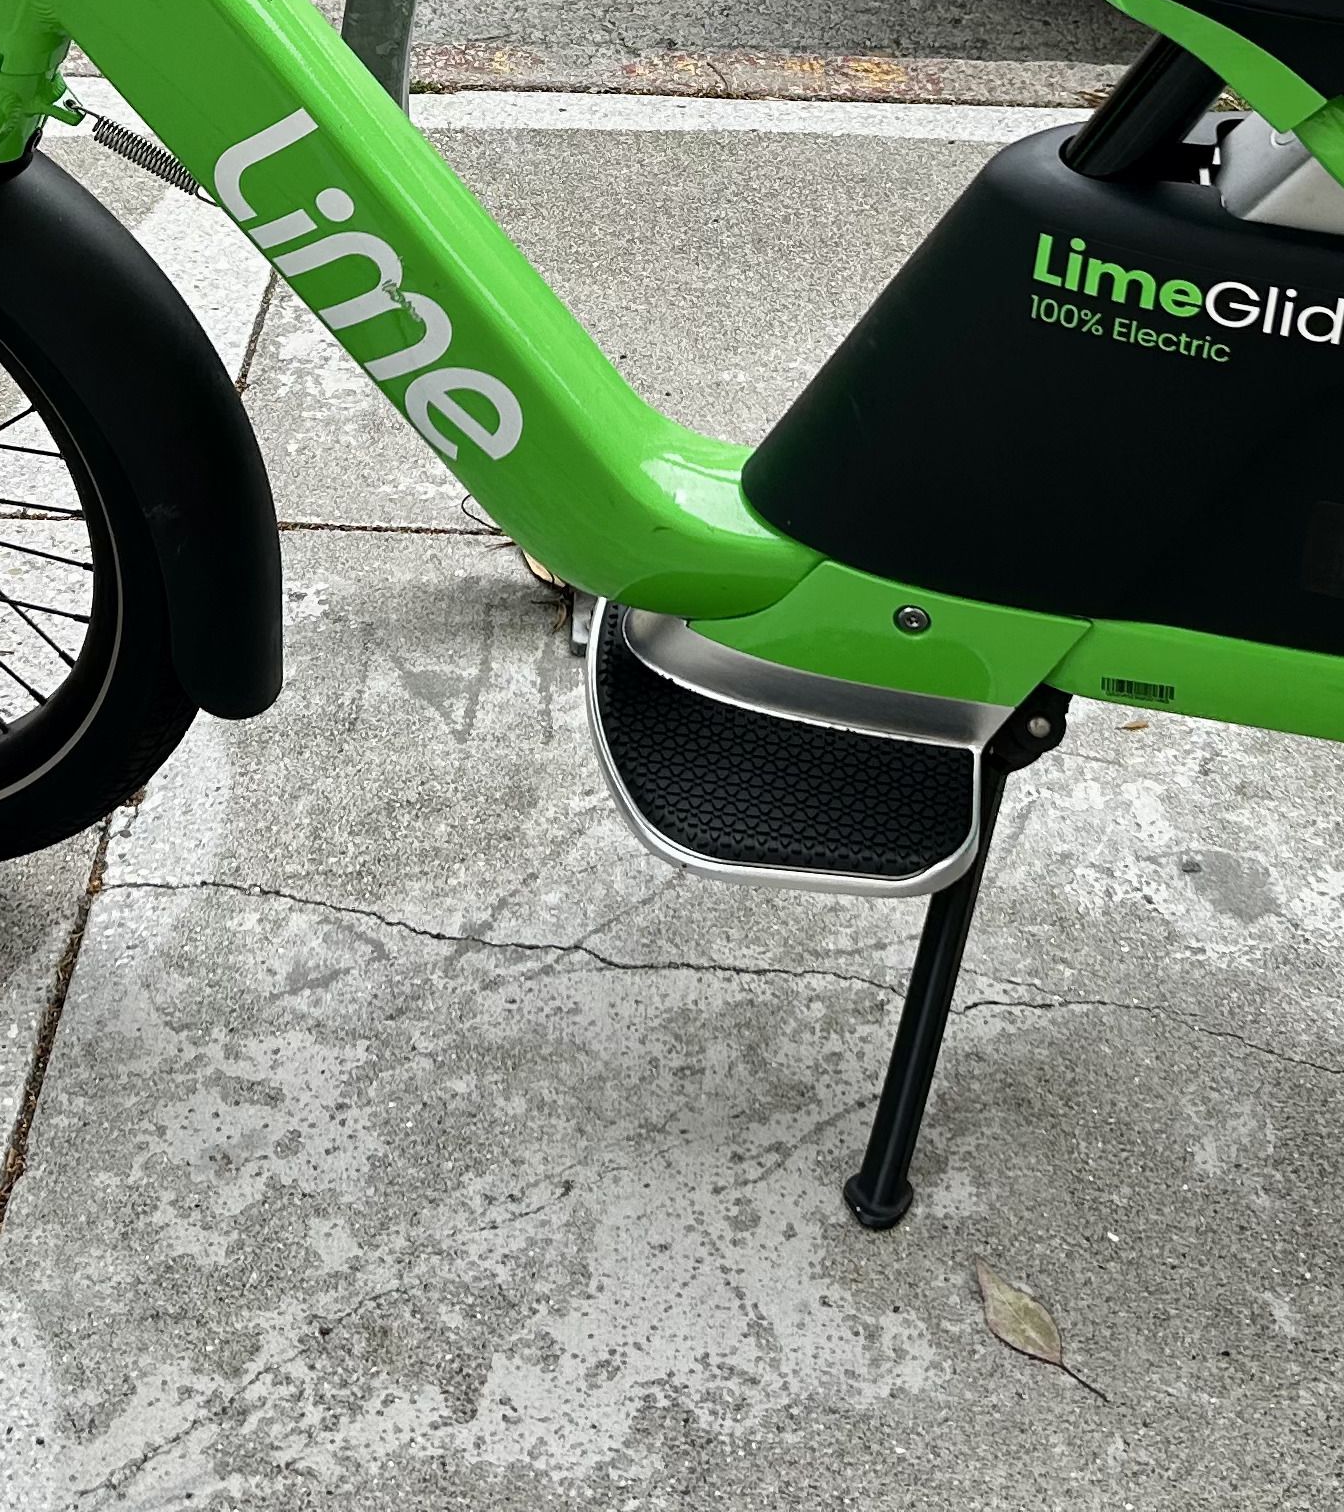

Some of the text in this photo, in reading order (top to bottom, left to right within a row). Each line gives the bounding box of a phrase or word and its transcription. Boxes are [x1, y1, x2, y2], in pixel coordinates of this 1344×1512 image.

[214, 108, 523, 461] Lime
[1030, 294, 1232, 364] 100% Electric
